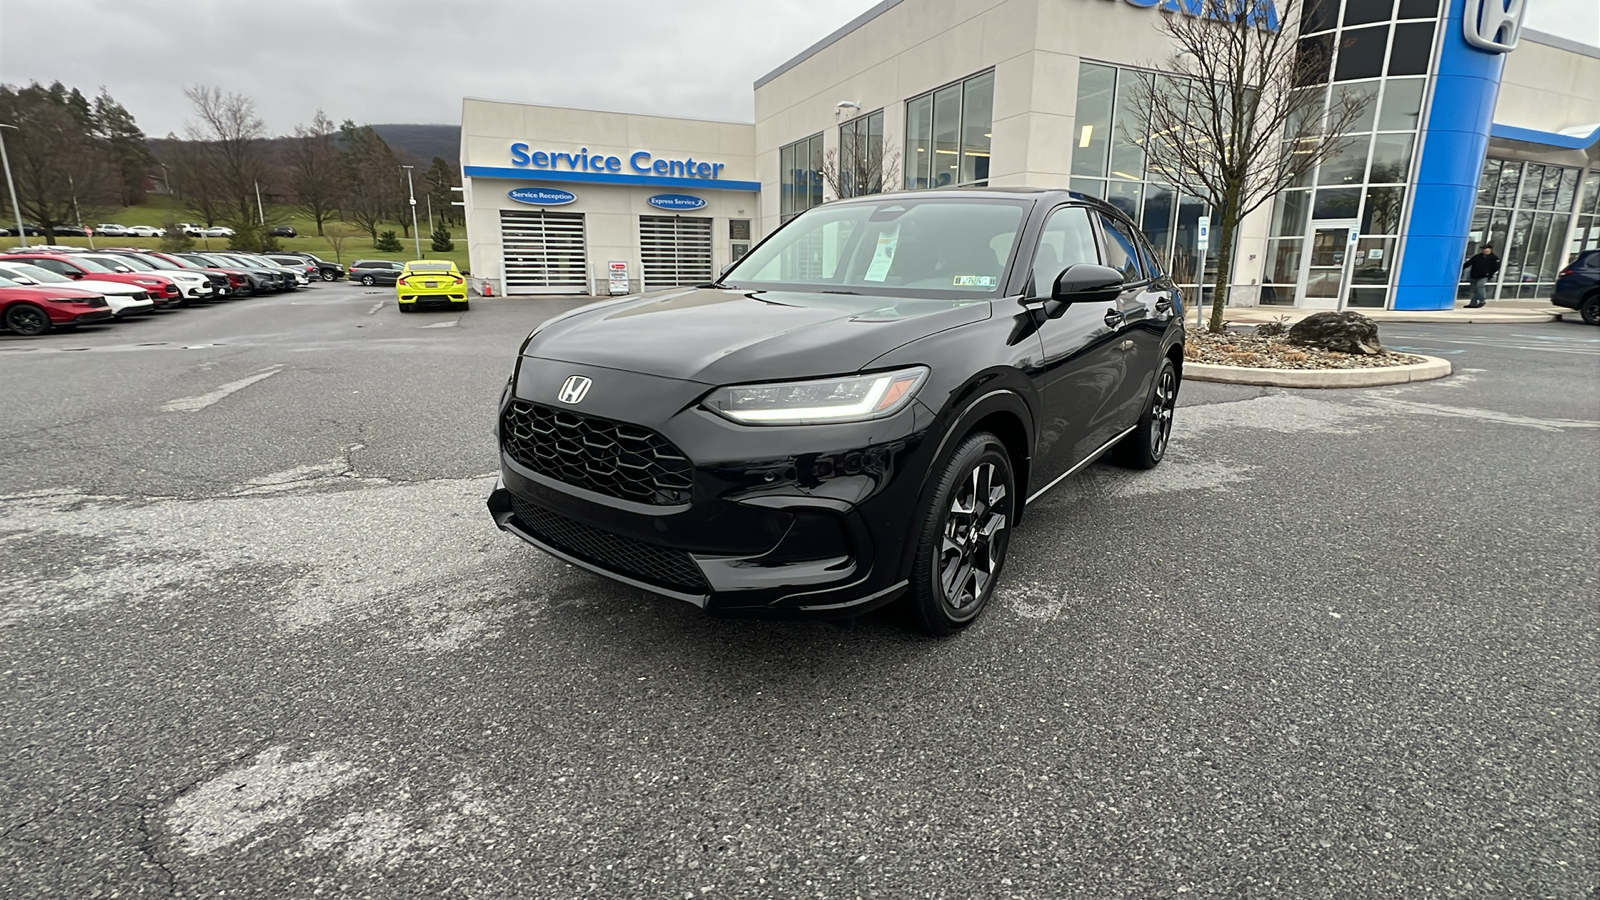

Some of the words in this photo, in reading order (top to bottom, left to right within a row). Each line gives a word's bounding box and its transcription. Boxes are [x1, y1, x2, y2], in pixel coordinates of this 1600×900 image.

[510, 142, 621, 172] Service
[629, 151, 725, 179] Center
[512, 190, 538, 199] Service
[538, 192, 573, 201] Reception
[651, 197, 674, 205] Express
